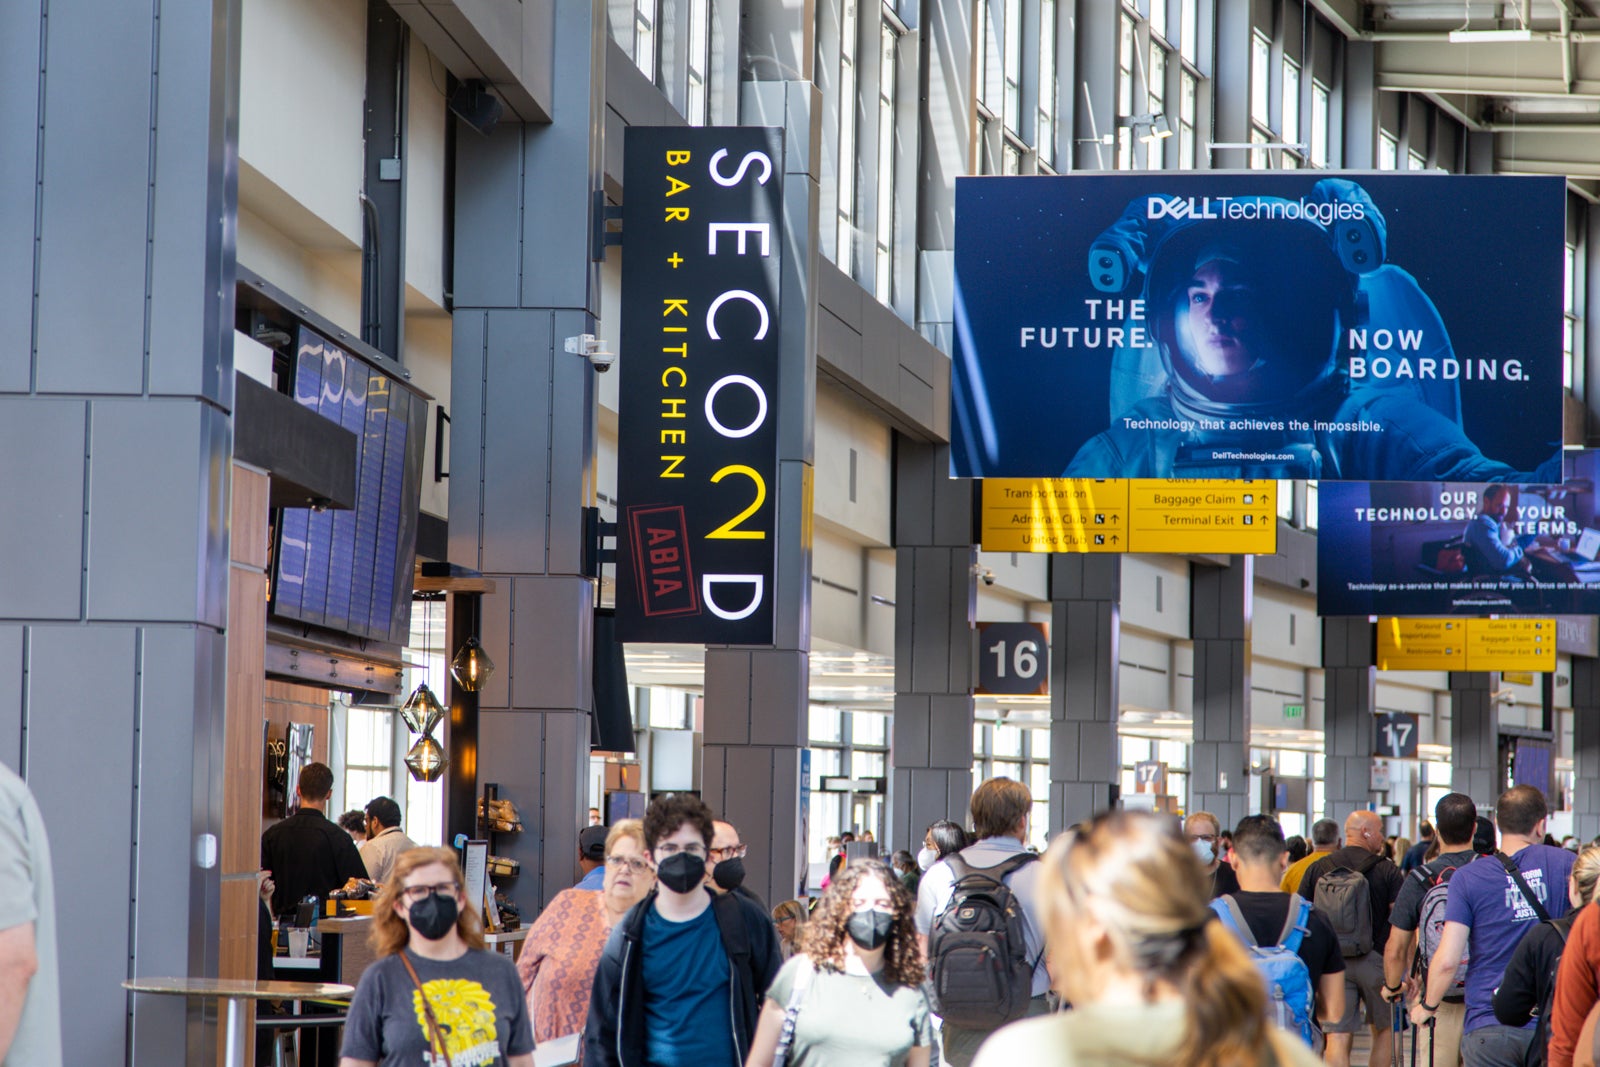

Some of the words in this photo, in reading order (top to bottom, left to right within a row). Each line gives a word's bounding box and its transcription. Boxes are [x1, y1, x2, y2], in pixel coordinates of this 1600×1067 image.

[664, 150, 691, 223] BAR
[1147, 196, 1217, 220] DELL
[1216, 197, 1365, 226] Technologies
[1085, 299, 1146, 320] THE
[1020, 327, 1153, 348] FUTURE.
[1349, 328, 1424, 350] NOW
[1349, 357, 1530, 381] BOARDING.
[659, 298, 688, 478] KITCHEN
[703, 148, 772, 621] SECO2D
[1123, 418, 1195, 432] Technology
[1200, 419, 1225, 430] that
[1229, 420, 1285, 431] achieves
[1289, 420, 1310, 431] the
[1313, 420, 1385, 434] impossible.
[1212, 451, 1295, 461] DellTechnologies.com
[1153, 493, 1202, 507] Baggage
[1205, 493, 1236, 505] Claim
[1440, 491, 1478, 505] OUR
[1163, 514, 1212, 526] Terminal
[1214, 514, 1235, 526] Exit
[1354, 507, 1478, 522] TECHNOLOGY.
[1516, 505, 1565, 519] YOUR
[647, 527, 683, 598] ABIA
[1347, 582, 1387, 592] Technology
[1433, 582, 1448, 590] that
[990, 640, 1038, 679] 16
[1382, 723, 1412, 747] 17
[1139, 765, 1158, 782] 17
